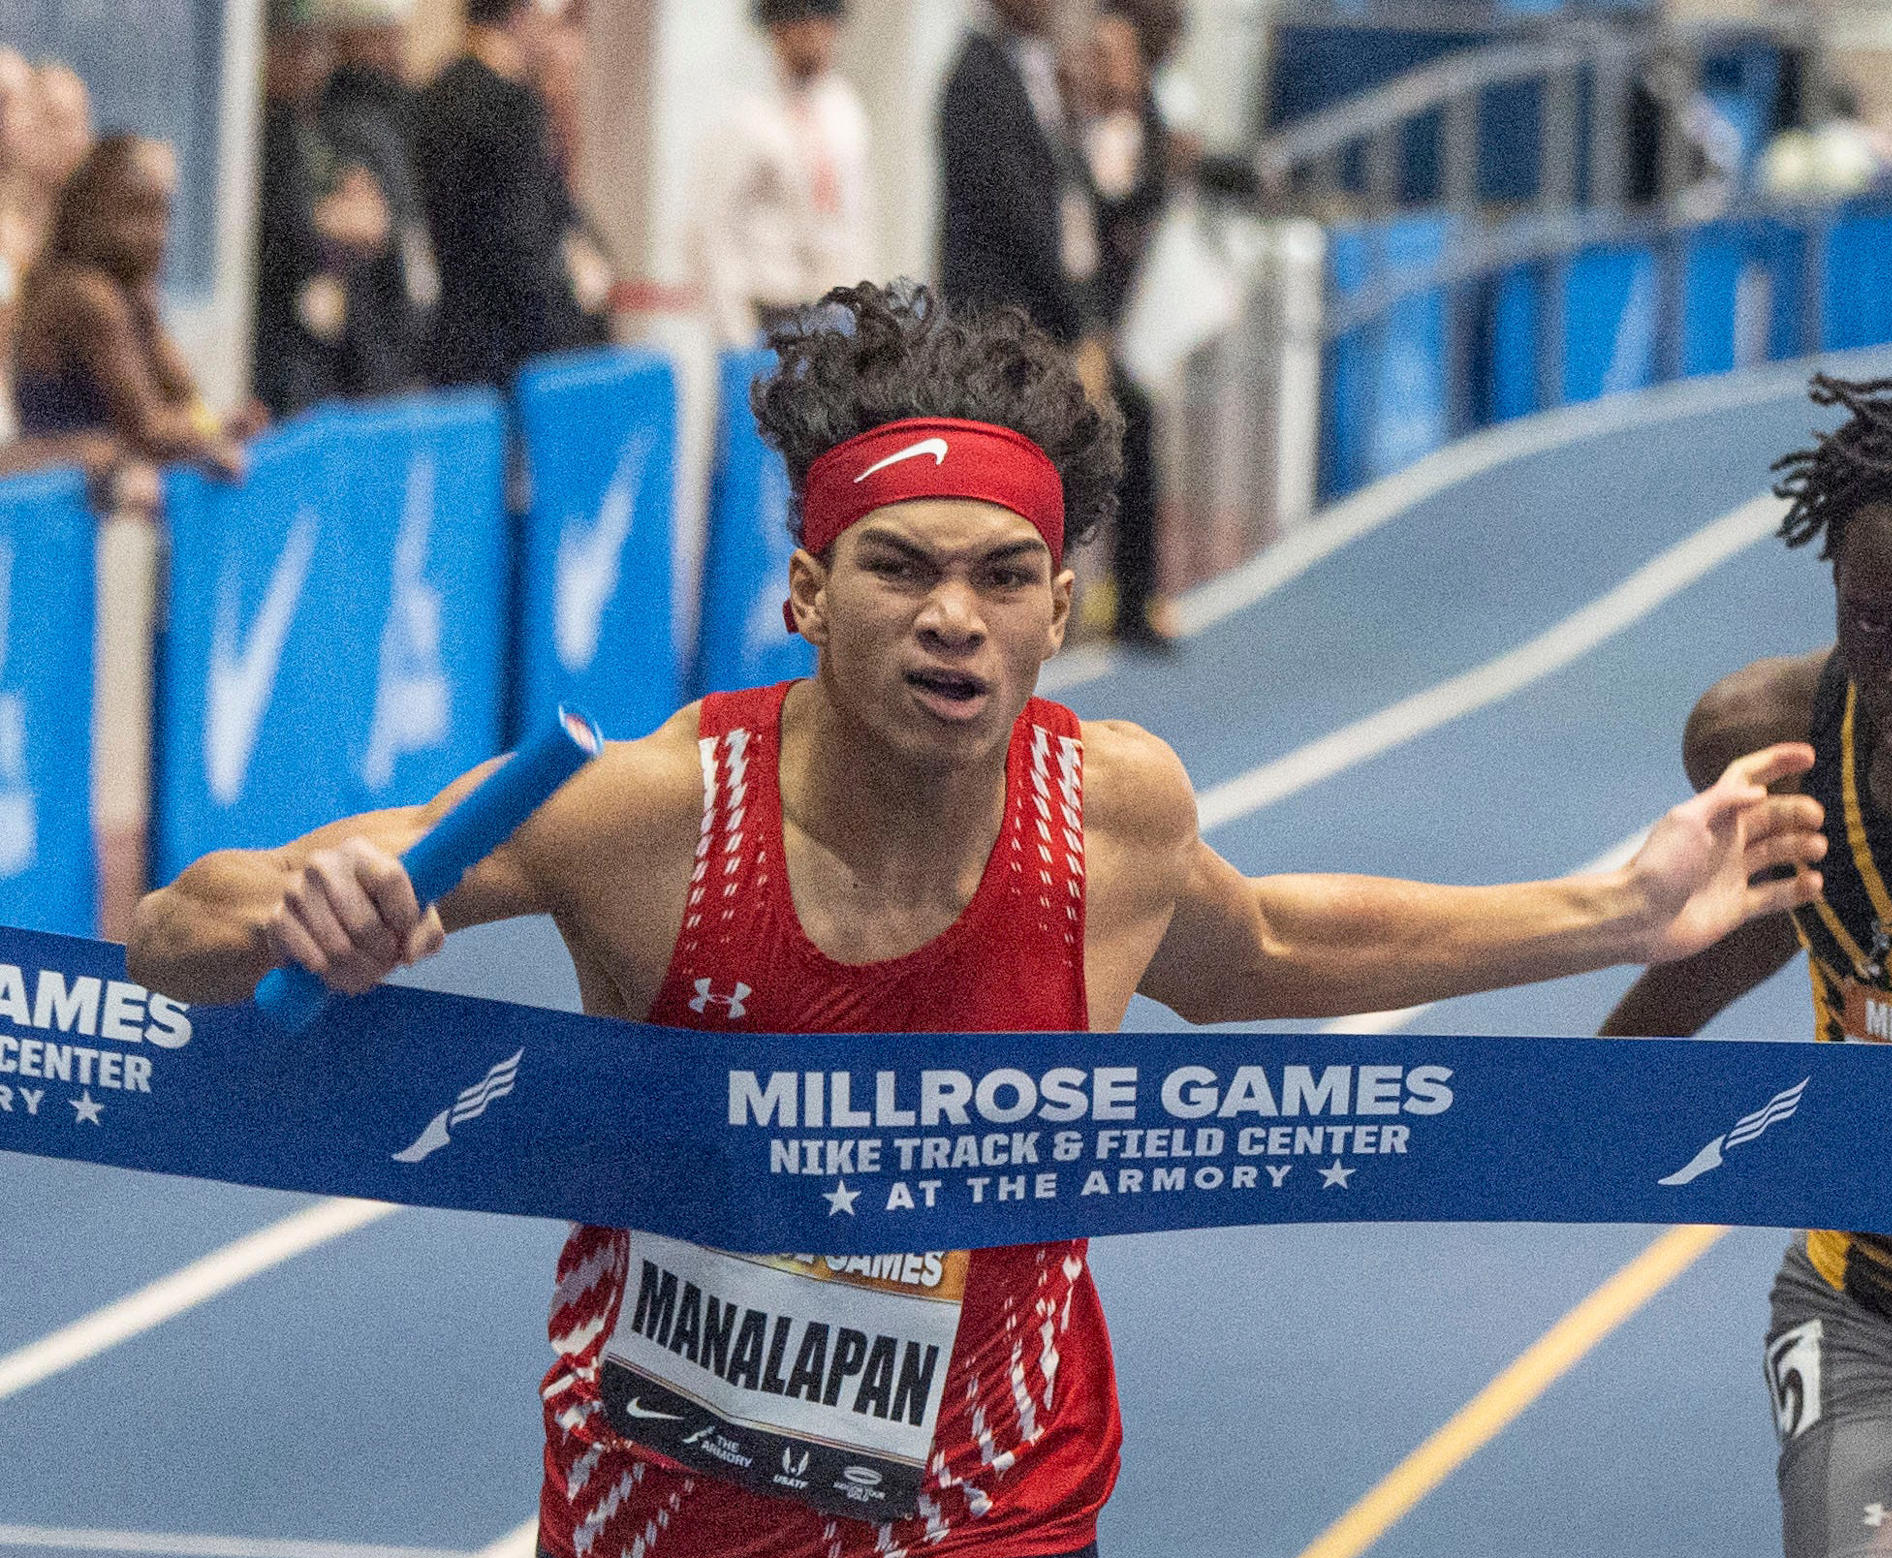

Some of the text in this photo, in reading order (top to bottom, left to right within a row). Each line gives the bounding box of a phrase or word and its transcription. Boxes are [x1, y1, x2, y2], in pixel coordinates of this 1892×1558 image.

[0, 1035, 152, 1092] CENTER
[728, 1064, 1454, 1128] MILLROSE GAMES
[770, 1125, 1411, 1176] NIKE TRACK & FIELD CENTER
[886, 1164, 1292, 1211] AT THE ARMORY
[631, 1259, 940, 1428] MANALAPAN
[701, 1440, 753, 1468] ARMORY
[717, 1435, 740, 1453] THE
